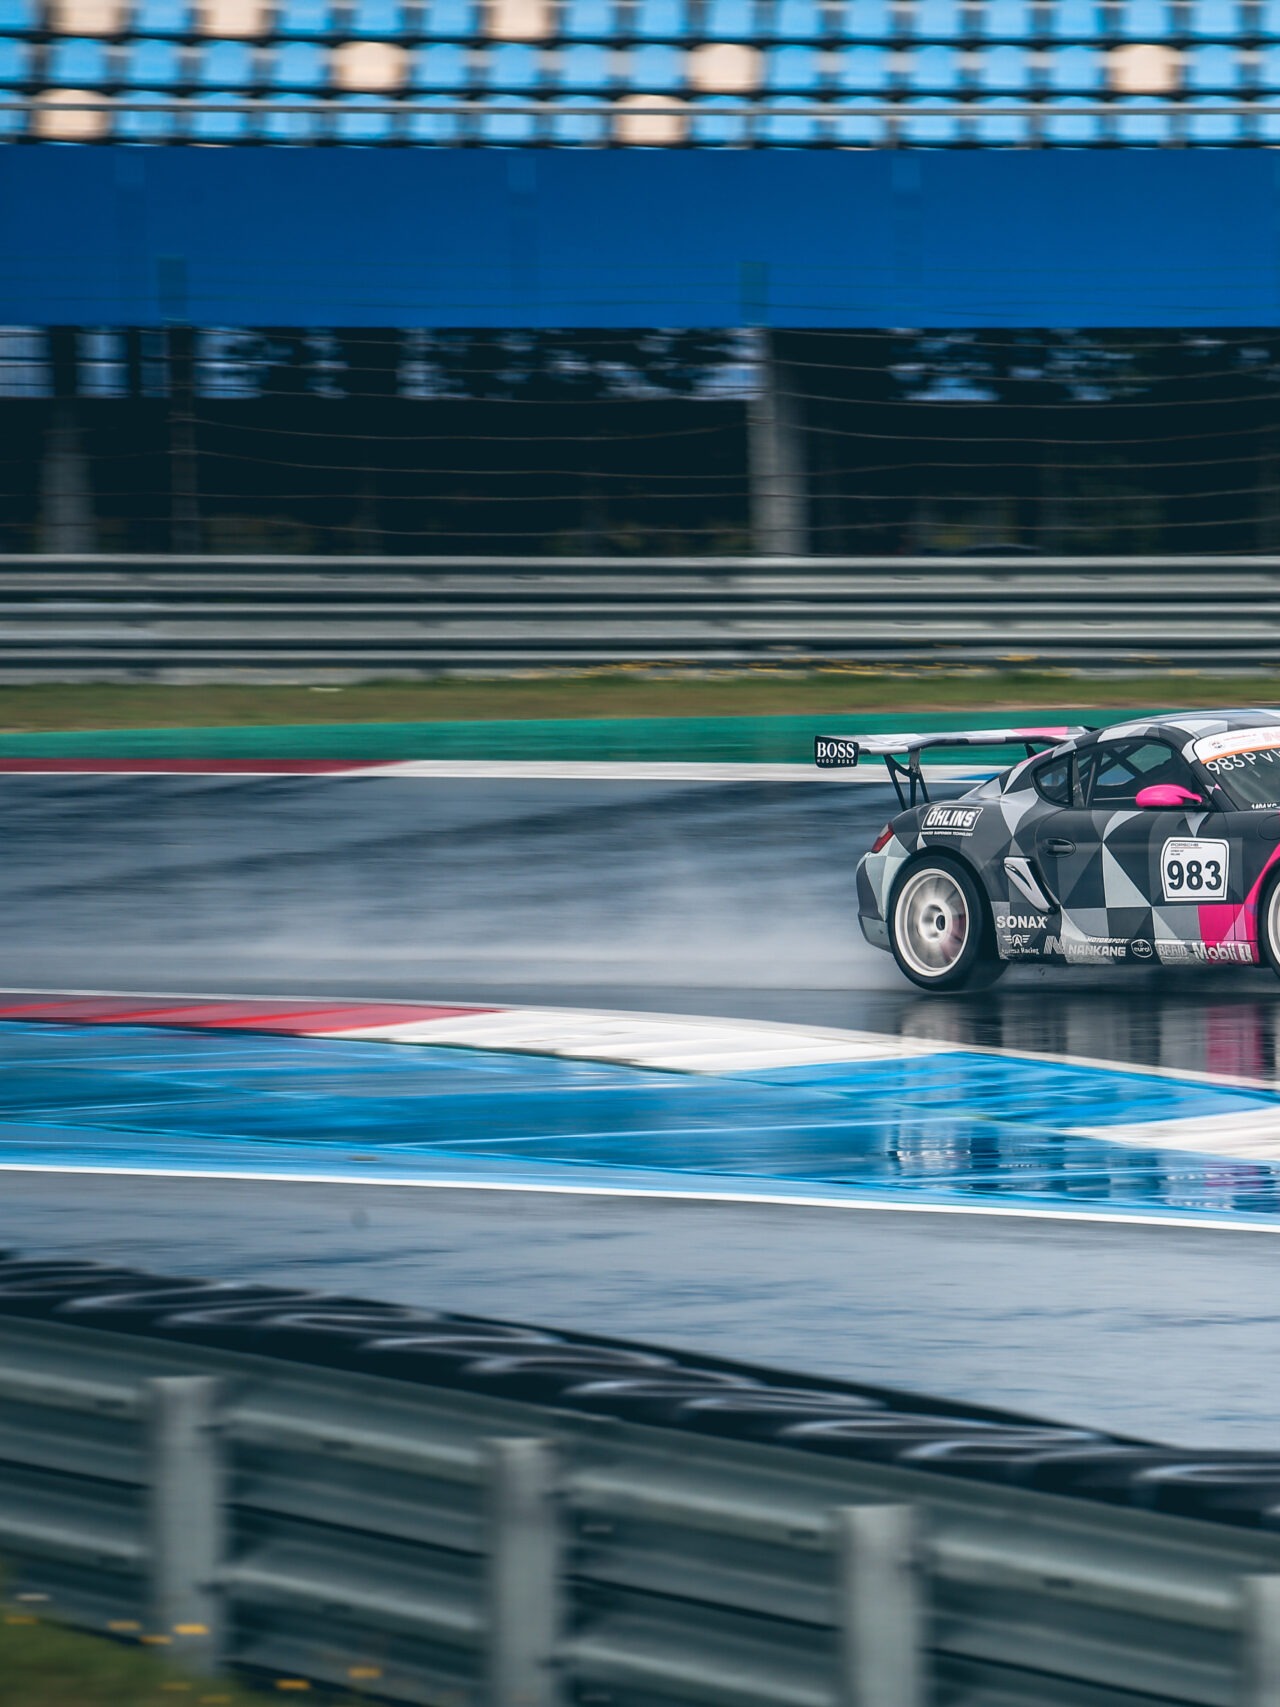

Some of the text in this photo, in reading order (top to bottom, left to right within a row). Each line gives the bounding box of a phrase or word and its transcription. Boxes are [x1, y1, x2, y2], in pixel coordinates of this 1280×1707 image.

[817, 742, 855, 758] BOSS
[1205, 754, 1245, 775] 983
[1242, 752, 1257, 765] P
[926, 807, 976, 827] ÖHLINS
[1167, 860, 1222, 890] 983
[996, 915, 1047, 929] SONAX
[1087, 936, 1129, 944] MOTORSPORT
[1068, 944, 1127, 957] NANKANG
[1191, 942, 1238, 961] Mobil
